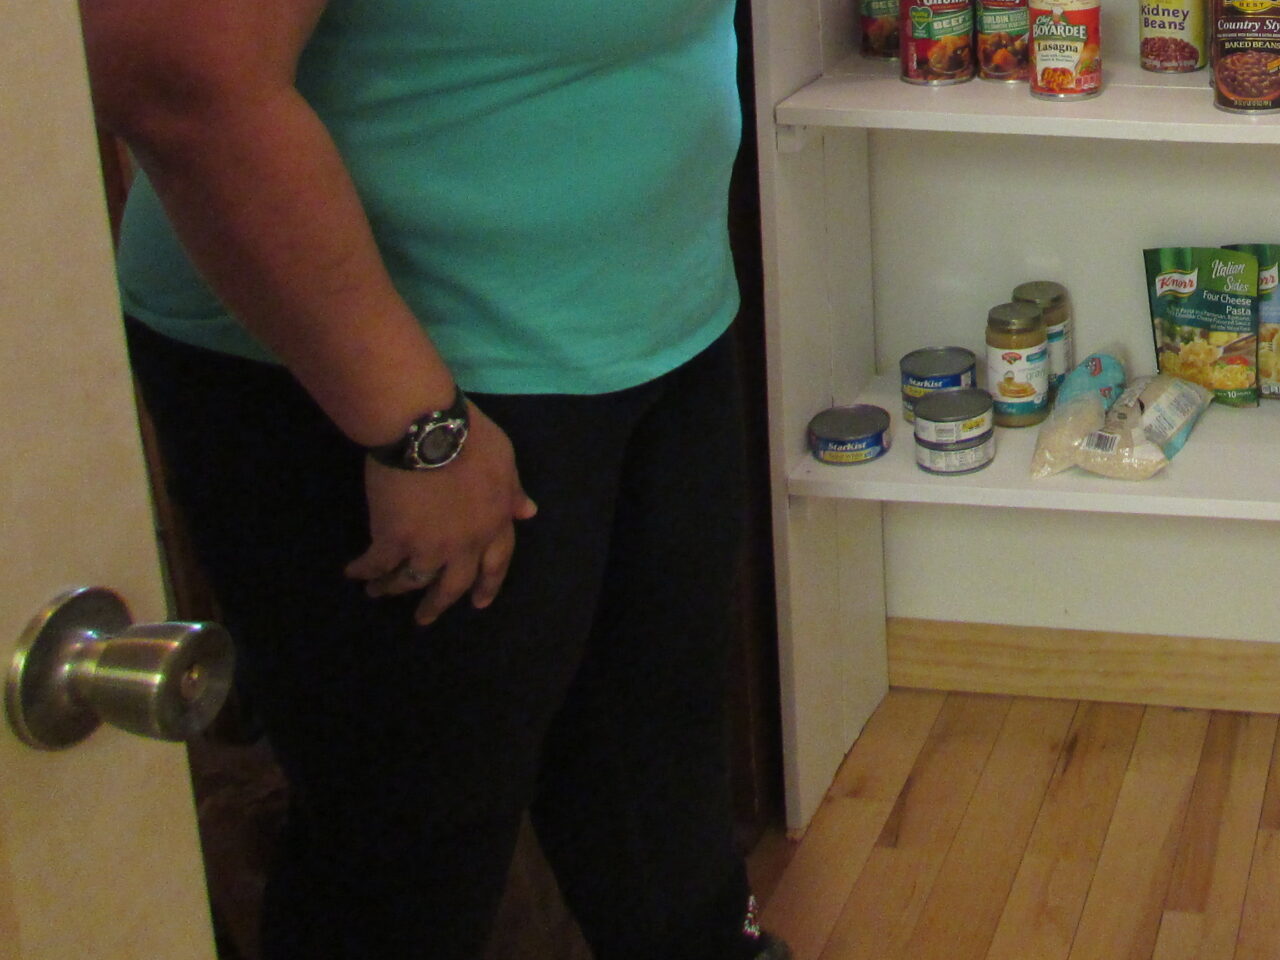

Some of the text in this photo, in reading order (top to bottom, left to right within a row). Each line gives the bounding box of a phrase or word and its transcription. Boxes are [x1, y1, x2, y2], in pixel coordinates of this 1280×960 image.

[1141, 4, 1190, 21] Kidney
[1144, 17, 1185, 30] Beans
[1217, 20, 1260, 31] Country
[1033, 24, 1086, 38] BOYARDEE
[1038, 43, 1078, 53] Lasagna
[1252, 41, 1280, 49] BEANS
[1212, 260, 1246, 278] Italian
[1160, 277, 1194, 288] Knorr
[1224, 276, 1248, 291] Sides
[1203, 290, 1251, 305] Four Cheese
[1226, 305, 1251, 316] Pasta
[909, 377, 943, 387] StarKist
[828, 442, 867, 451] StarKist
